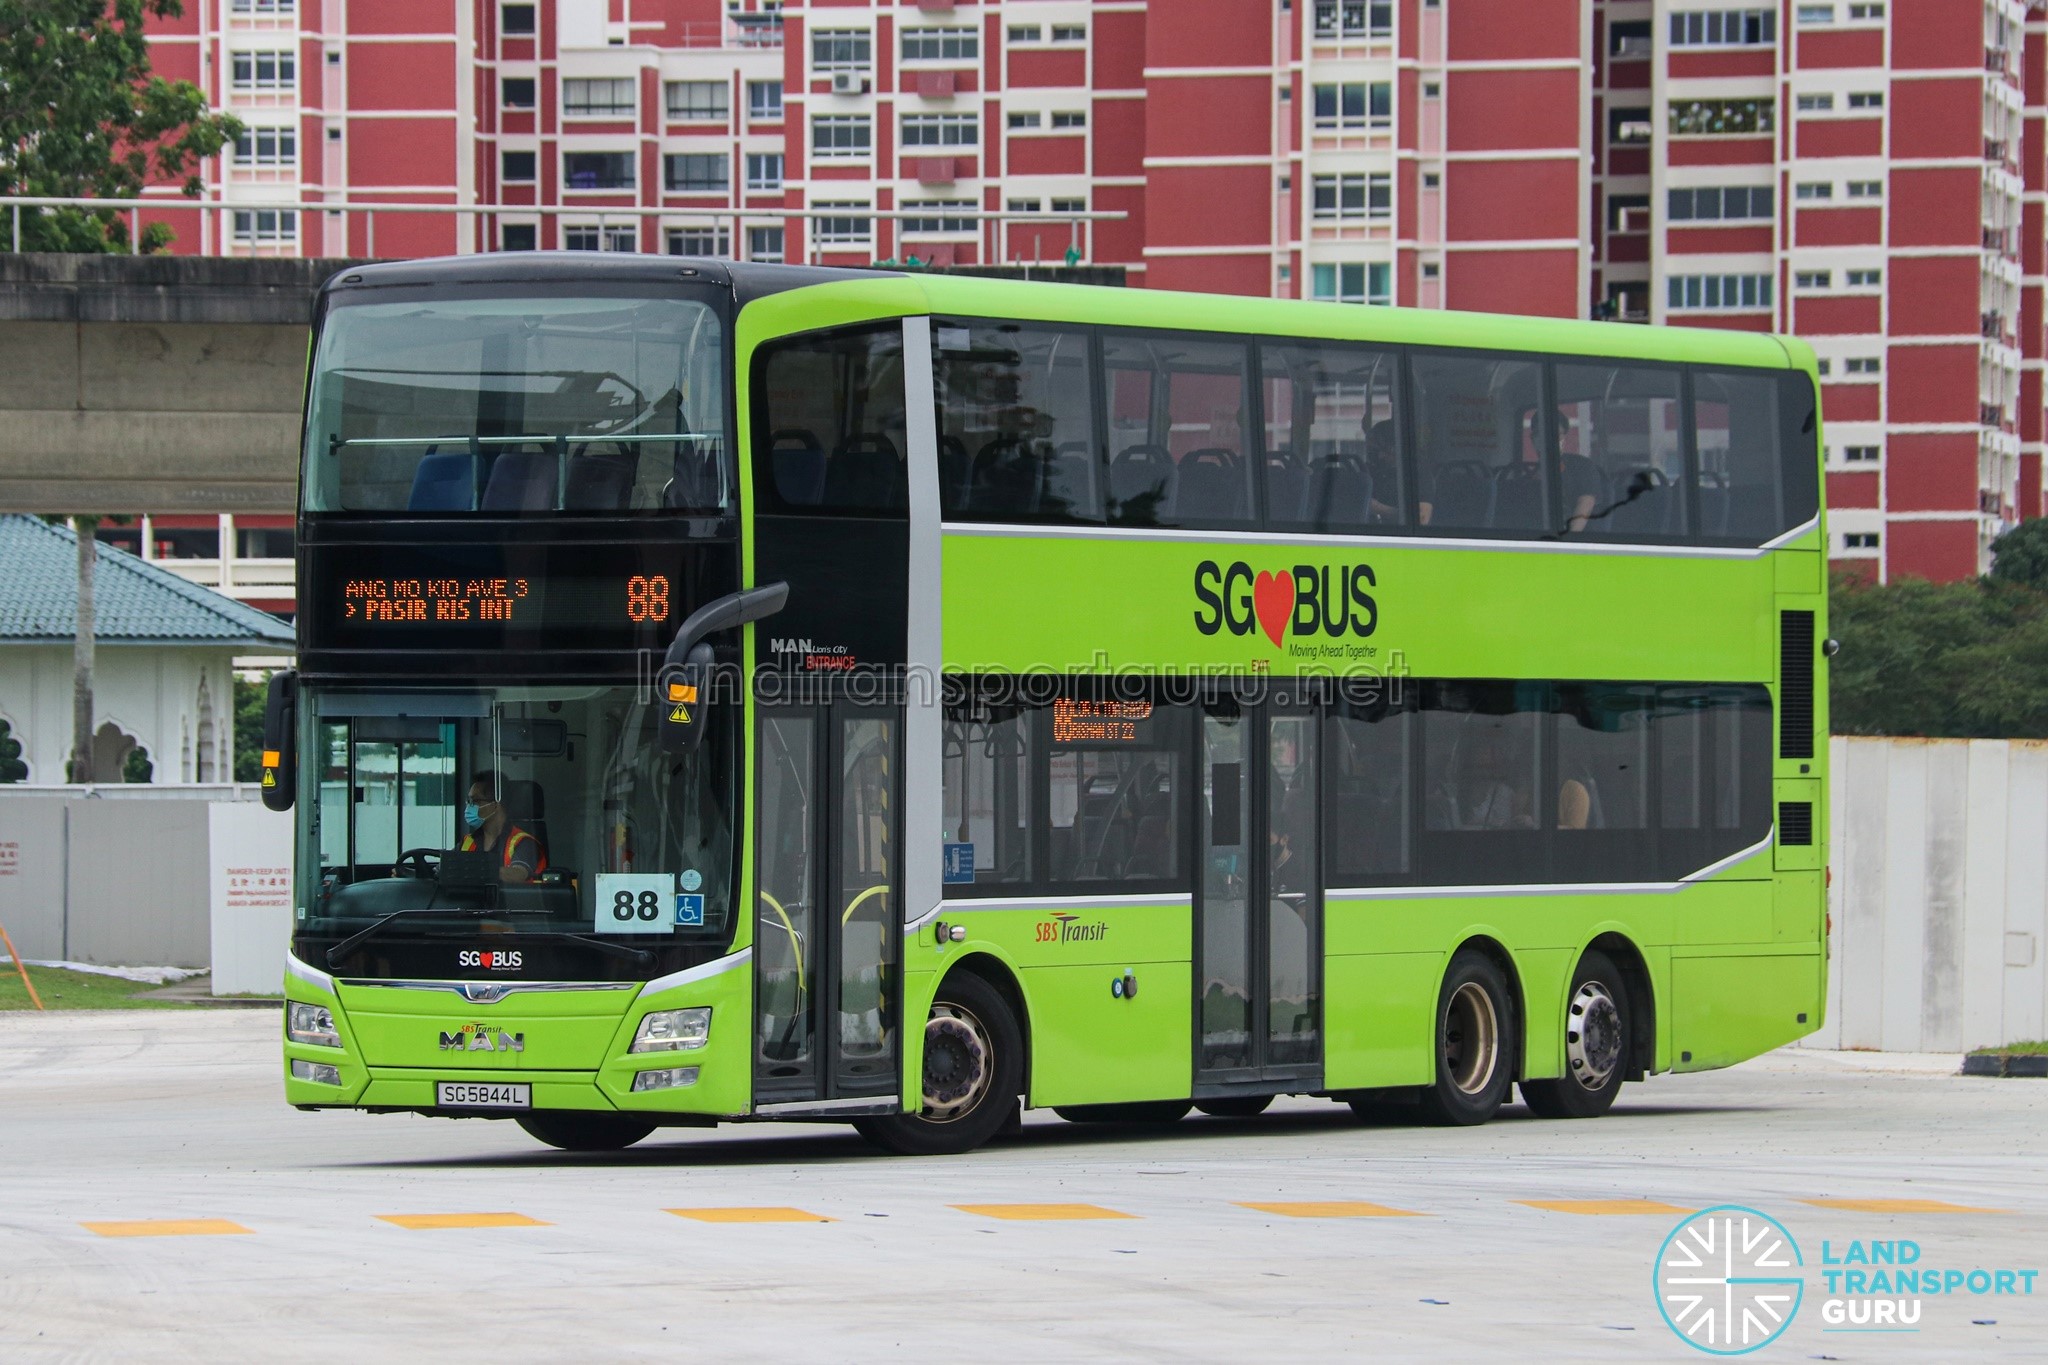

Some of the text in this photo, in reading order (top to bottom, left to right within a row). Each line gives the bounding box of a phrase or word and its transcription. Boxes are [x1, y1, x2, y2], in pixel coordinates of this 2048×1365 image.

[345, 579, 529, 598] ANG MO KIO AVE 3
[627, 575, 669, 622] 88
[365, 599, 514, 621] PASIR RIS INT
[770, 638, 812, 654] MAN
[832, 644, 848, 655] City
[1289, 643, 1378, 661] Moving Ahead Together
[806, 655, 856, 671] ENTRANCE
[1251, 660, 1270, 673] EXIT
[1106, 721, 1120, 739] ST
[1121, 722, 1136, 739] 22
[613, 890, 659, 921] 88
[1035, 915, 1110, 946] SBS Transit
[460, 1022, 503, 1034] SBS Transit
[439, 1031, 525, 1052] MAN
[444, 1085, 524, 1104] SG5844L
